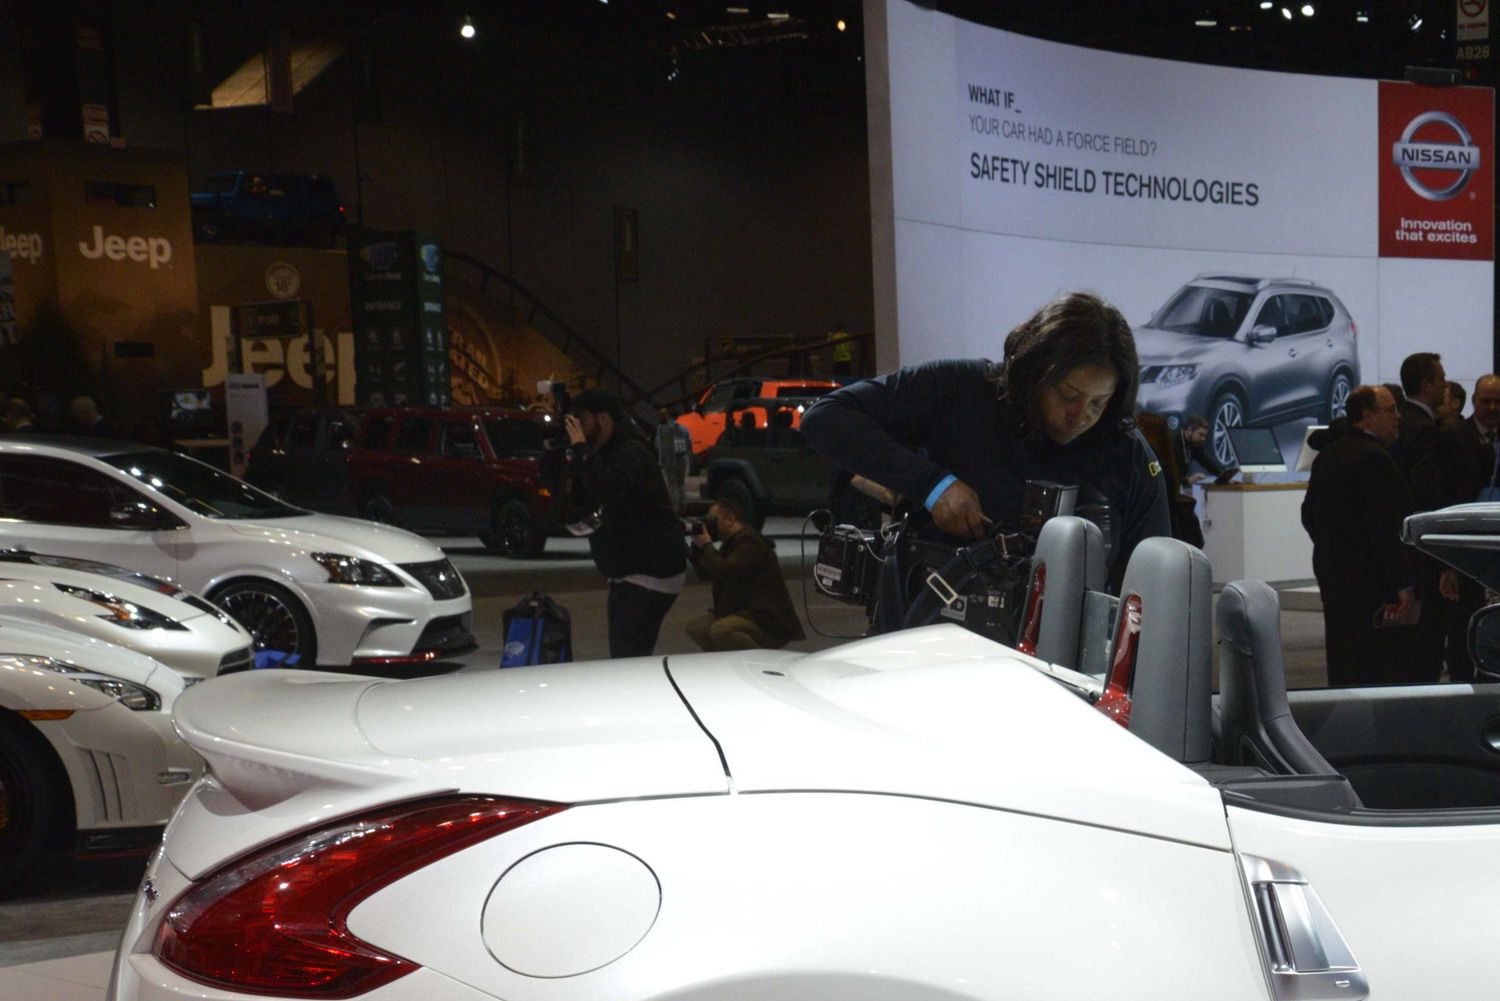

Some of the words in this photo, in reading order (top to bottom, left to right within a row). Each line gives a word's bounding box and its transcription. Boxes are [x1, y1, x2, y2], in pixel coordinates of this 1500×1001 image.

[1456, 45, 1490, 60] AB28
[968, 83, 1000, 107] WHAT
[968, 113, 1000, 137] YOUR
[1002, 119, 1026, 141] CAR
[1028, 125, 1053, 146] HAD
[1056, 130, 1064, 148] A
[1067, 131, 1110, 153] FORCE
[1114, 136, 1157, 158] FIELD?
[1402, 148, 1471, 164] NISSAN
[970, 152, 1030, 186] SAFETY
[1034, 162, 1096, 193] SHIELD
[1102, 171, 1259, 206] TECHNOLOGIES
[1401, 217, 1472, 232] Innovation
[1395, 229, 1424, 241] that
[1428, 231, 1477, 244] excites
[79, 225, 173, 270] Jeep
